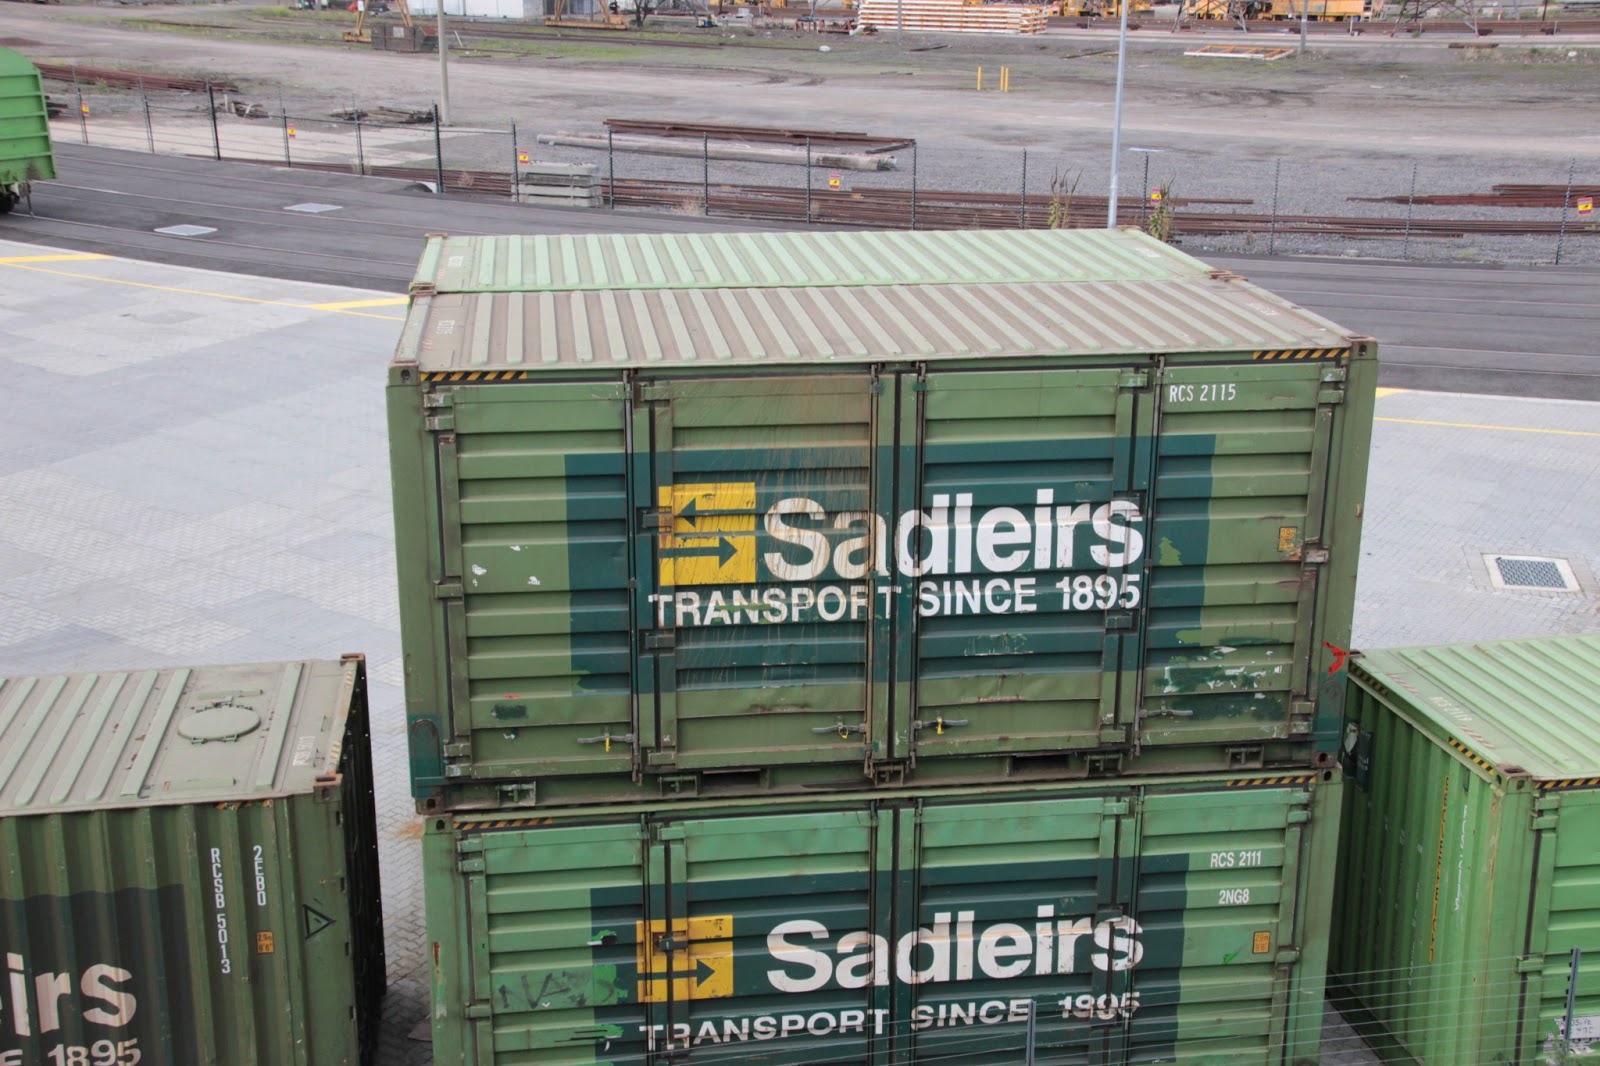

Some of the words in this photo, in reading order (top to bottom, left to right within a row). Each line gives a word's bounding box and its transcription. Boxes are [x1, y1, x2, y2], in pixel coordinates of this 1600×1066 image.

[1169, 385, 1194, 402] RCS
[1199, 384, 1236, 401] 2115
[764, 488, 1143, 581] Sadleirs
[648, 585, 902, 628] TRANSPORT
[920, 578, 1037, 617] SINCE
[1056, 574, 1140, 610] 1895
[211, 848, 225, 908] RCSB
[1211, 852, 1234, 868] RCS
[1239, 851, 1261, 866] 2111
[1219, 888, 1249, 904] 2NG8
[217, 914, 230, 973] 5013
[766, 905, 1143, 993] Sadleirs
[0, 952, 137, 1037] irs
[639, 1009, 889, 1051] TRANSPORT
[911, 999, 1032, 1031] SINCE
